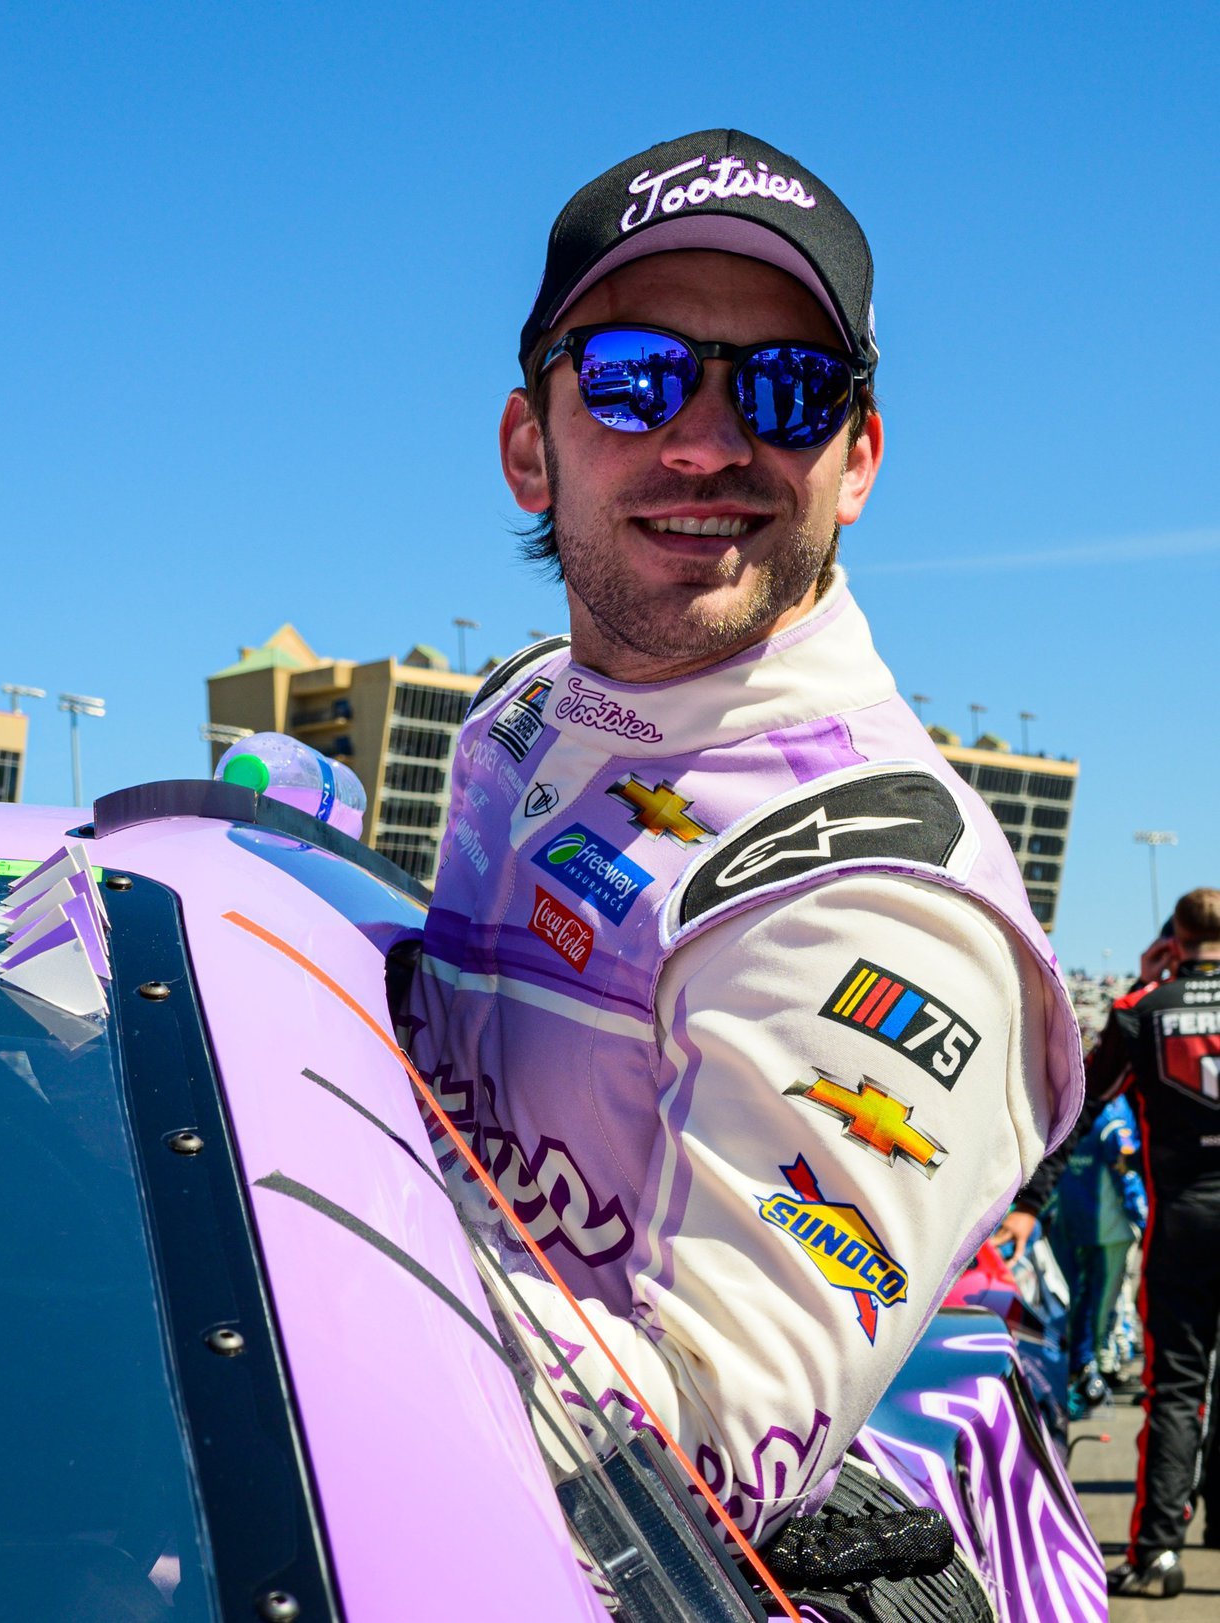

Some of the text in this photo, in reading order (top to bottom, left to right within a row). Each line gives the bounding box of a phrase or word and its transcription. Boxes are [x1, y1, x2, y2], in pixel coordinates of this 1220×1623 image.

[619, 155, 817, 234] Tootsies
[504, 709, 537, 740] CUP SERIES
[555, 677, 663, 743] Tootsies
[564, 863, 624, 912] INSURANCE
[576, 843, 638, 899] Freeway
[902, 1001, 974, 1078] 75
[772, 1199, 906, 1301] SUNOCO
